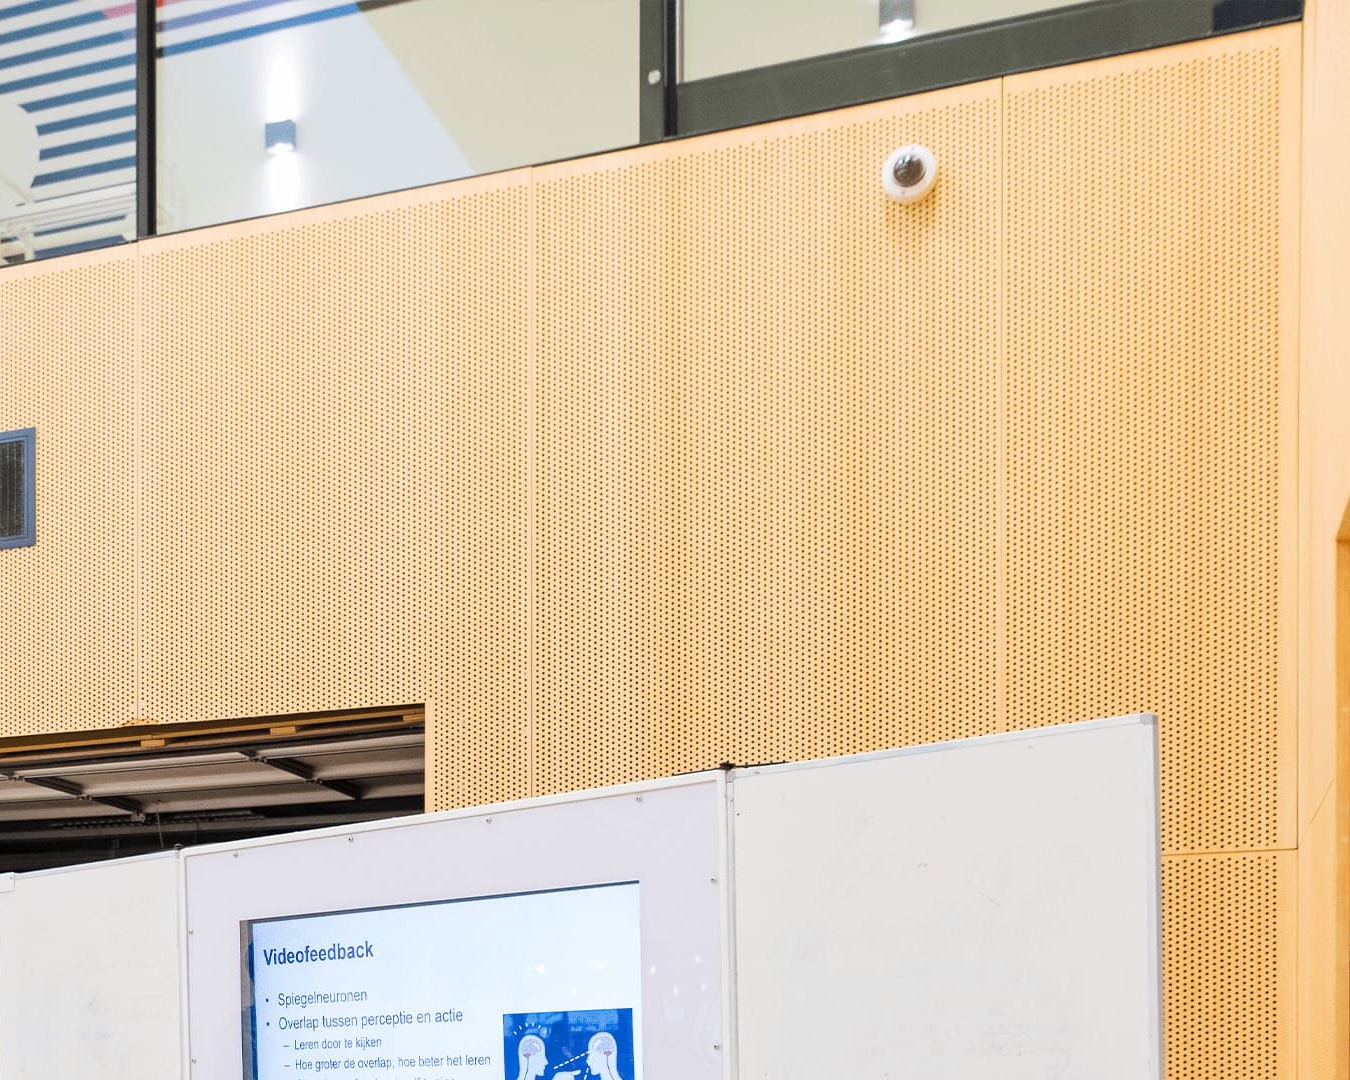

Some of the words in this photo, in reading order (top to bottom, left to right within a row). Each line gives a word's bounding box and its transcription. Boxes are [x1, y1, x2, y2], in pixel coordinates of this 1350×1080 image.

[263, 940, 374, 966] Videofeedback
[278, 989, 368, 1009] Spiegelneuronen
[278, 1015, 319, 1031] Overlap
[322, 1014, 358, 1028] tussen
[361, 1010, 413, 1030] perceptie
[416, 1011, 431, 1024] en
[434, 1007, 463, 1023] actie
[294, 1039, 319, 1050] Leren
[322, 1036, 341, 1049] door
[344, 1037, 353, 1048] te
[355, 1036, 382, 1051] kijken
[295, 1058, 313, 1070] Hoe
[315, 1058, 341, 1073] groter
[343, 1057, 355, 1069] de
[398, 1056, 416, 1068] hoe
[418, 1055, 444, 1067] beter
[447, 1054, 463, 1066] het
[465, 1053, 491, 1066] leren
